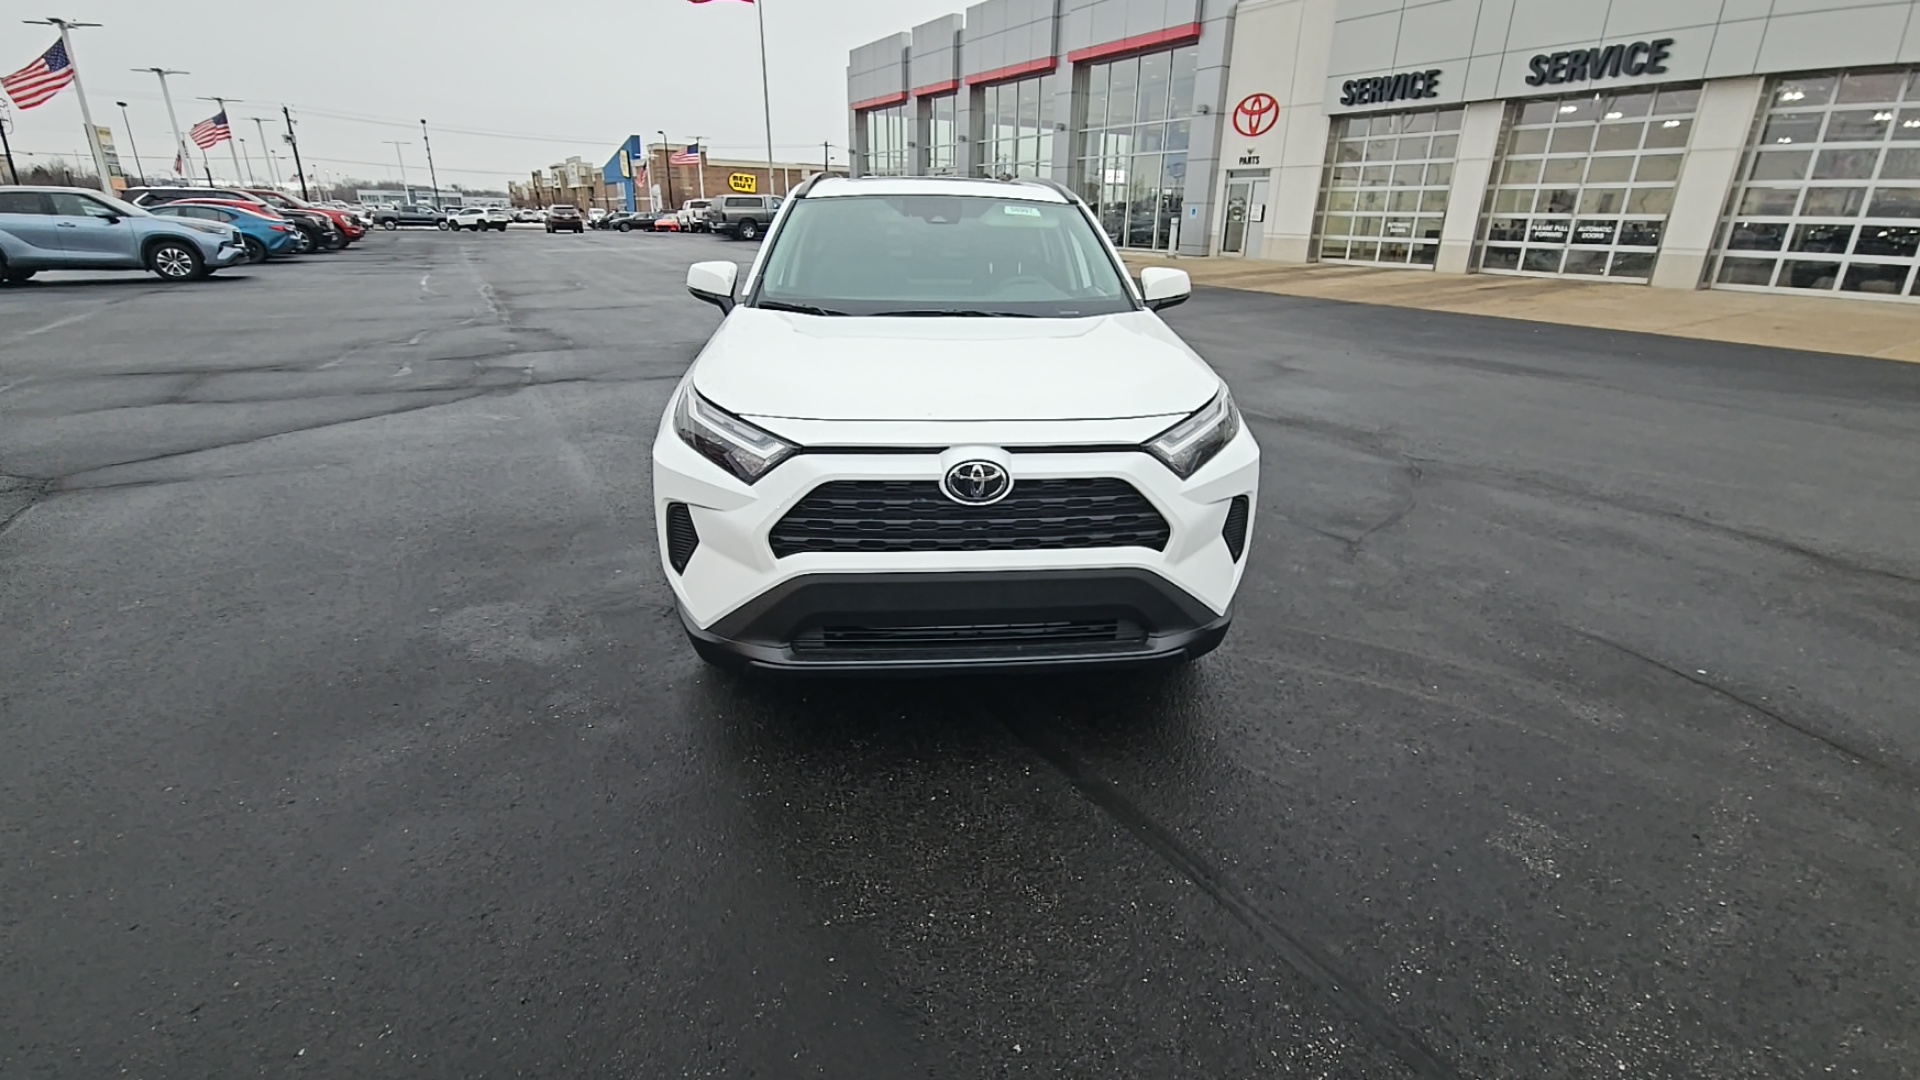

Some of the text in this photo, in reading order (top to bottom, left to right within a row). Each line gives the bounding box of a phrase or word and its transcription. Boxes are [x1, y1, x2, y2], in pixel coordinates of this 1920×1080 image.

[1524, 38, 1675, 87] SERVICE
[1340, 69, 1442, 106] SERVICE
[1239, 156, 1260, 165] PARTS
[732, 175, 754, 183] BEST
